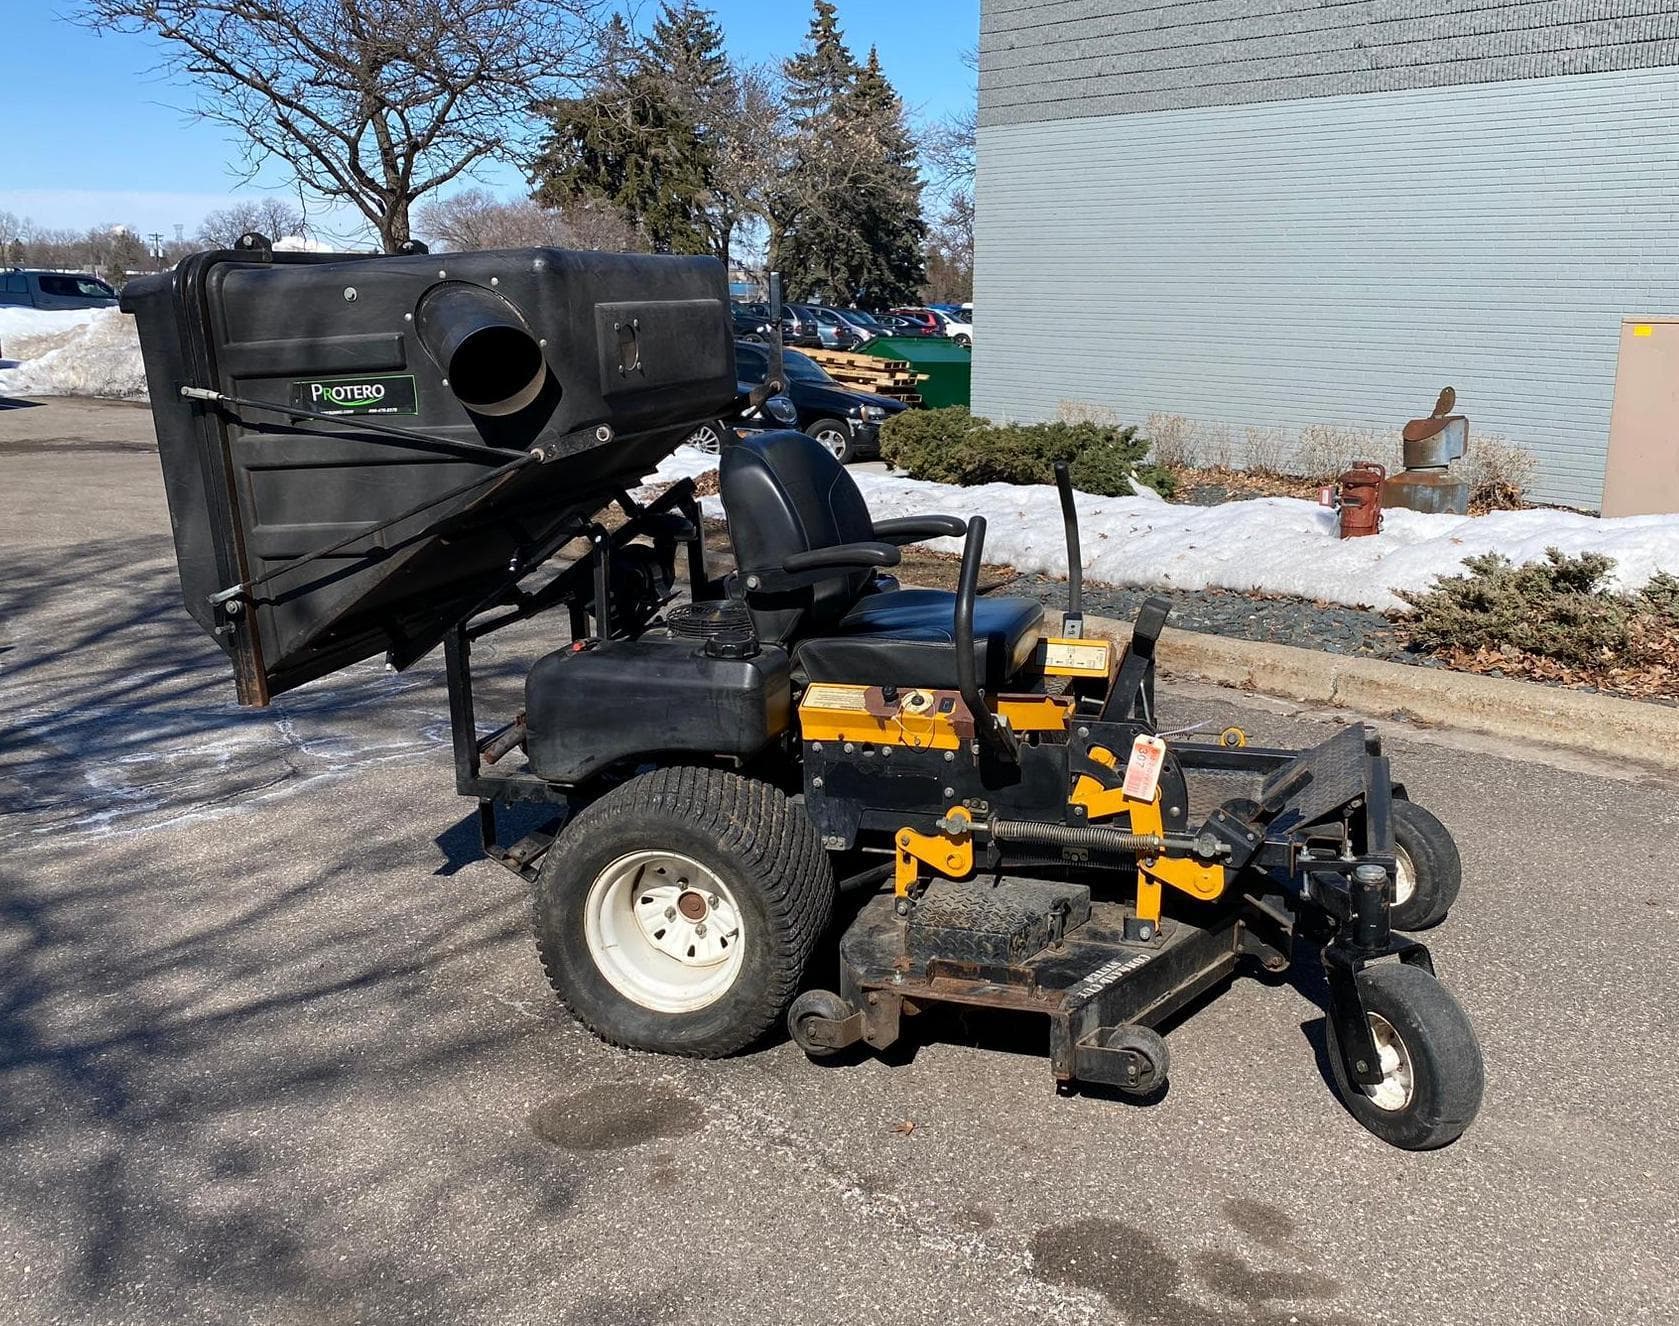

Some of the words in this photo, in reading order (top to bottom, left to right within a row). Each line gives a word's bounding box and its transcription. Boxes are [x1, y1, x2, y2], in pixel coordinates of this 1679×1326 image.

[311, 383, 385, 402] PROTERO
[1136, 747, 1148, 768] 307
[1083, 960, 1122, 983] SYSTEM
[1076, 983, 1103, 999] CUT
